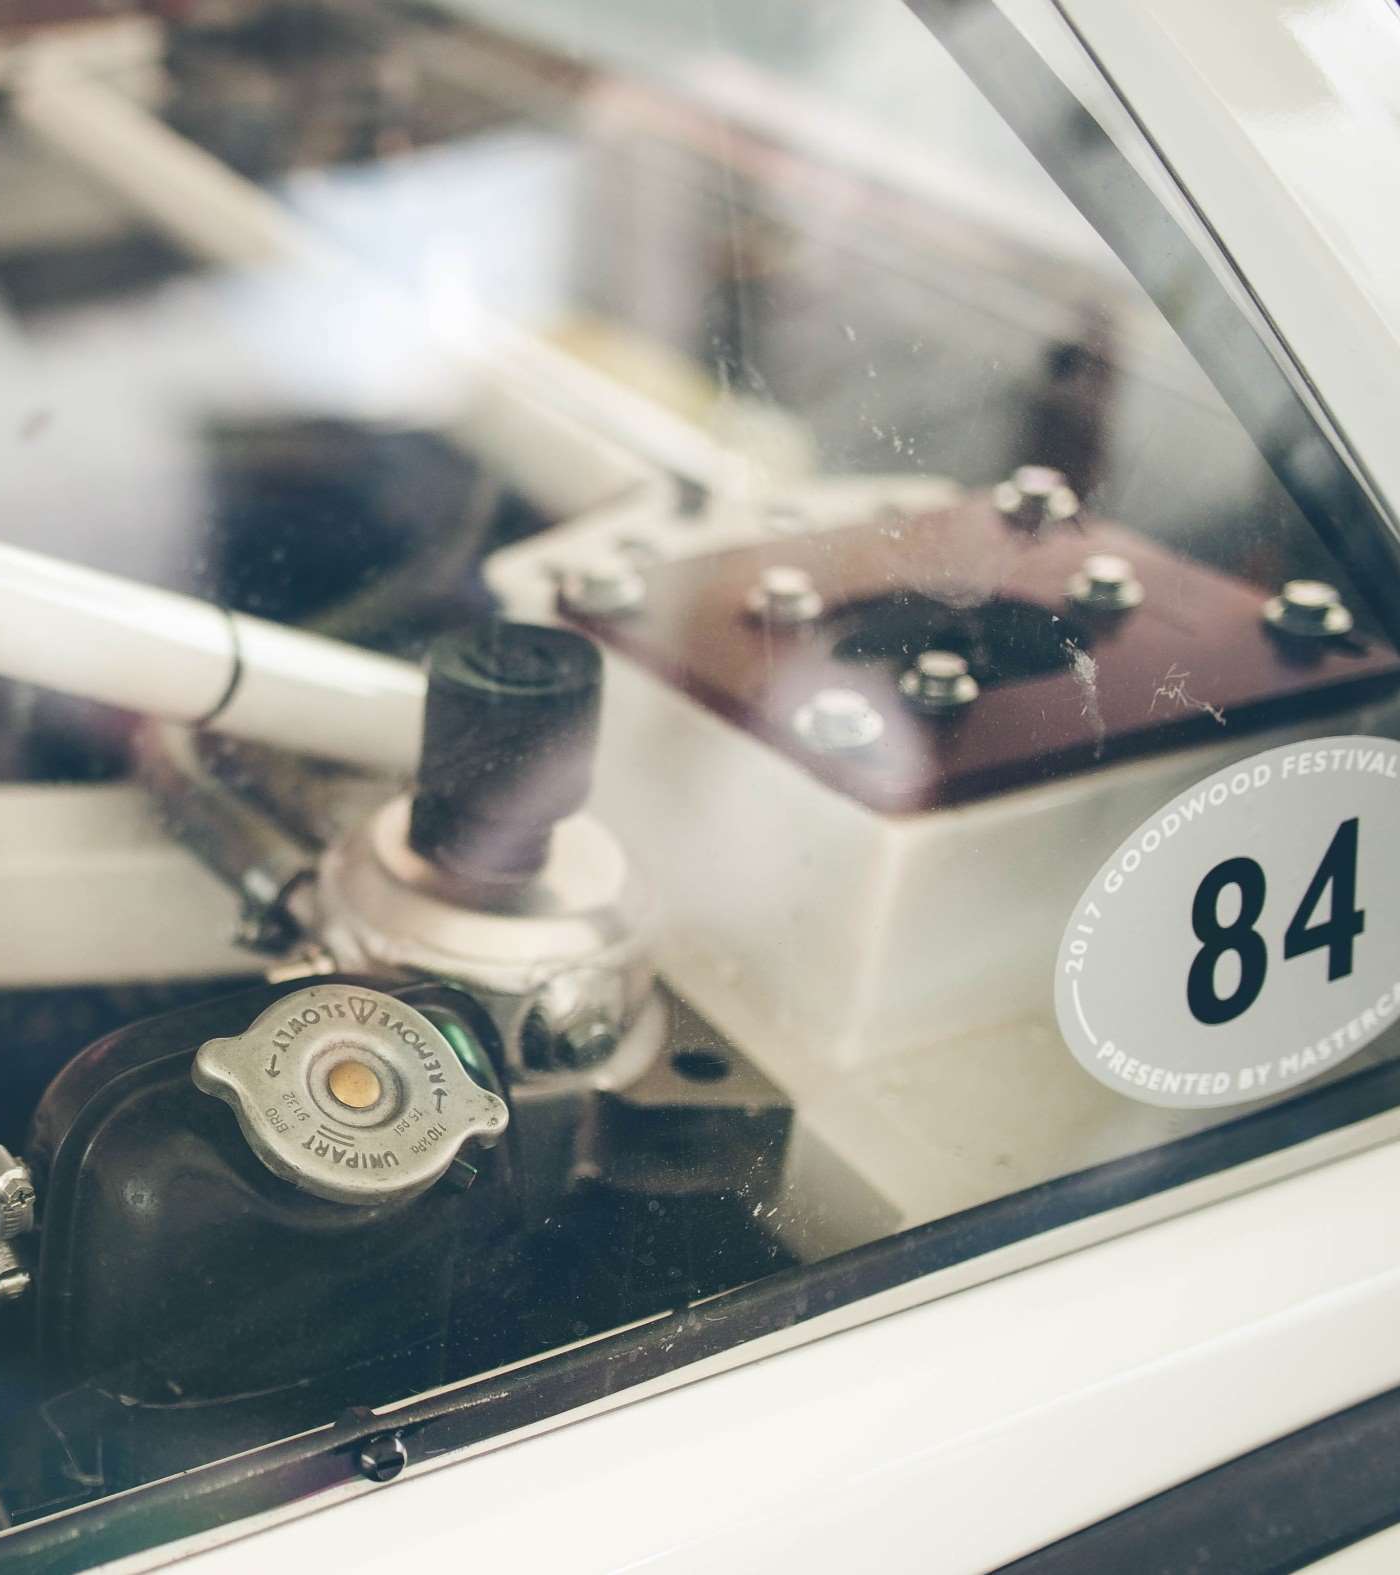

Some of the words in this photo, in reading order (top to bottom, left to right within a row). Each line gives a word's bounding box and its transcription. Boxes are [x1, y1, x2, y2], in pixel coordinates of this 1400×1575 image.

[1065, 902, 1102, 974] 2017
[1104, 764, 1273, 895] GOODWOOD
[1281, 748, 1399, 780] FESTIVAL
[1186, 816, 1366, 1027] 84
[271, 1003, 348, 1053] SLOWLY
[381, 1011, 447, 1085] REMOVE
[1097, 1040, 1230, 1095] PRESENTED
[1238, 1063, 1273, 1092] BY
[282, 1092, 311, 1122] 9132
[301, 1135, 400, 1170] UNIPART
